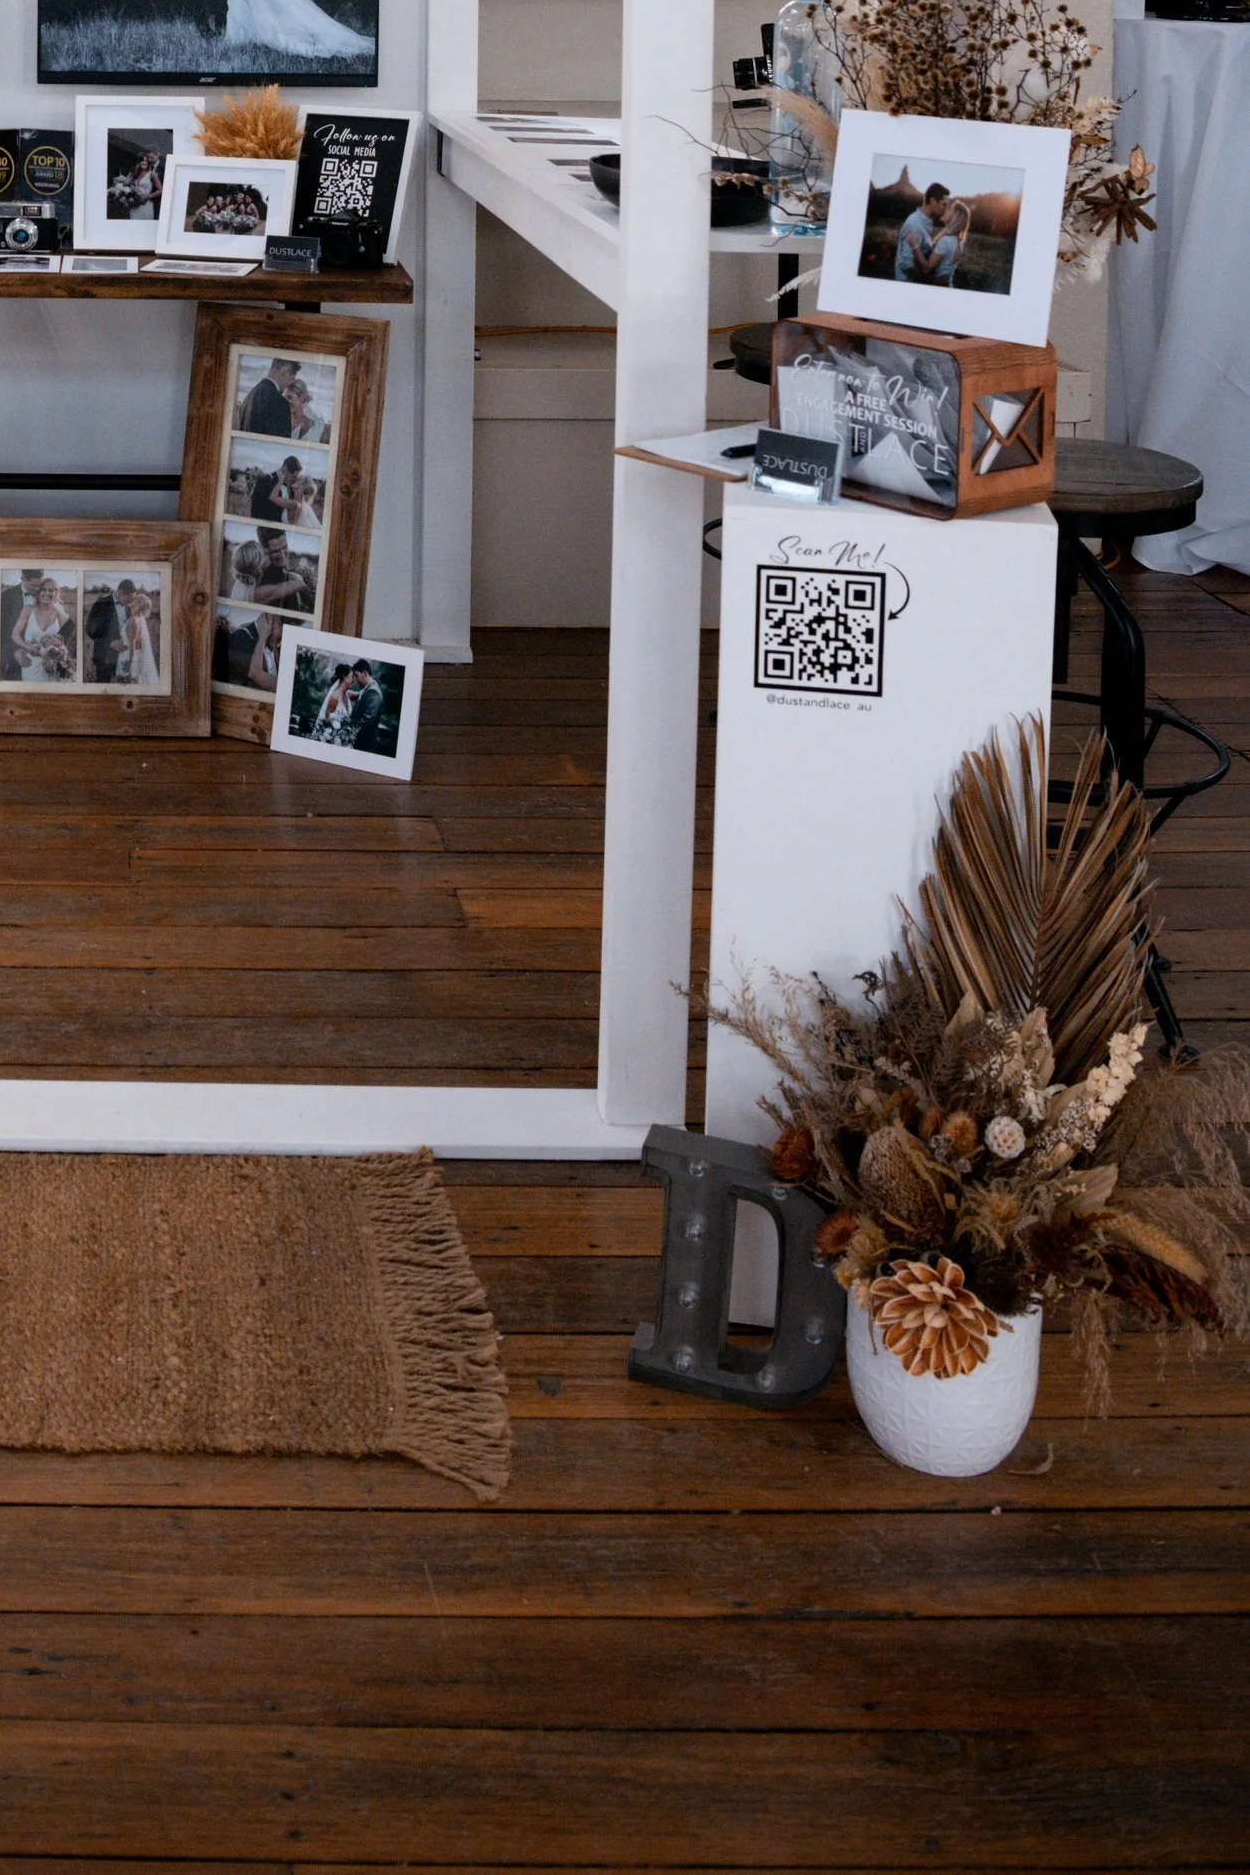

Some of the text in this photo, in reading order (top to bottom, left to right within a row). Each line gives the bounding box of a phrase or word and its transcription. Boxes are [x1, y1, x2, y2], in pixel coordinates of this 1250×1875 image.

[314, 124, 362, 146] Follow
[364, 134, 380, 147] us
[32, 155, 66, 168] TOP 10
[328, 144, 376, 158] SOCIAL MEDIA
[270, 246, 312, 258] DUSTLACE
[845, 390, 887, 412] A FREE
[798, 393, 938, 439] ENGAGEMENT SESSION
[762, 454, 828, 479] DUSTLACE
[770, 535, 823, 564] Scan
